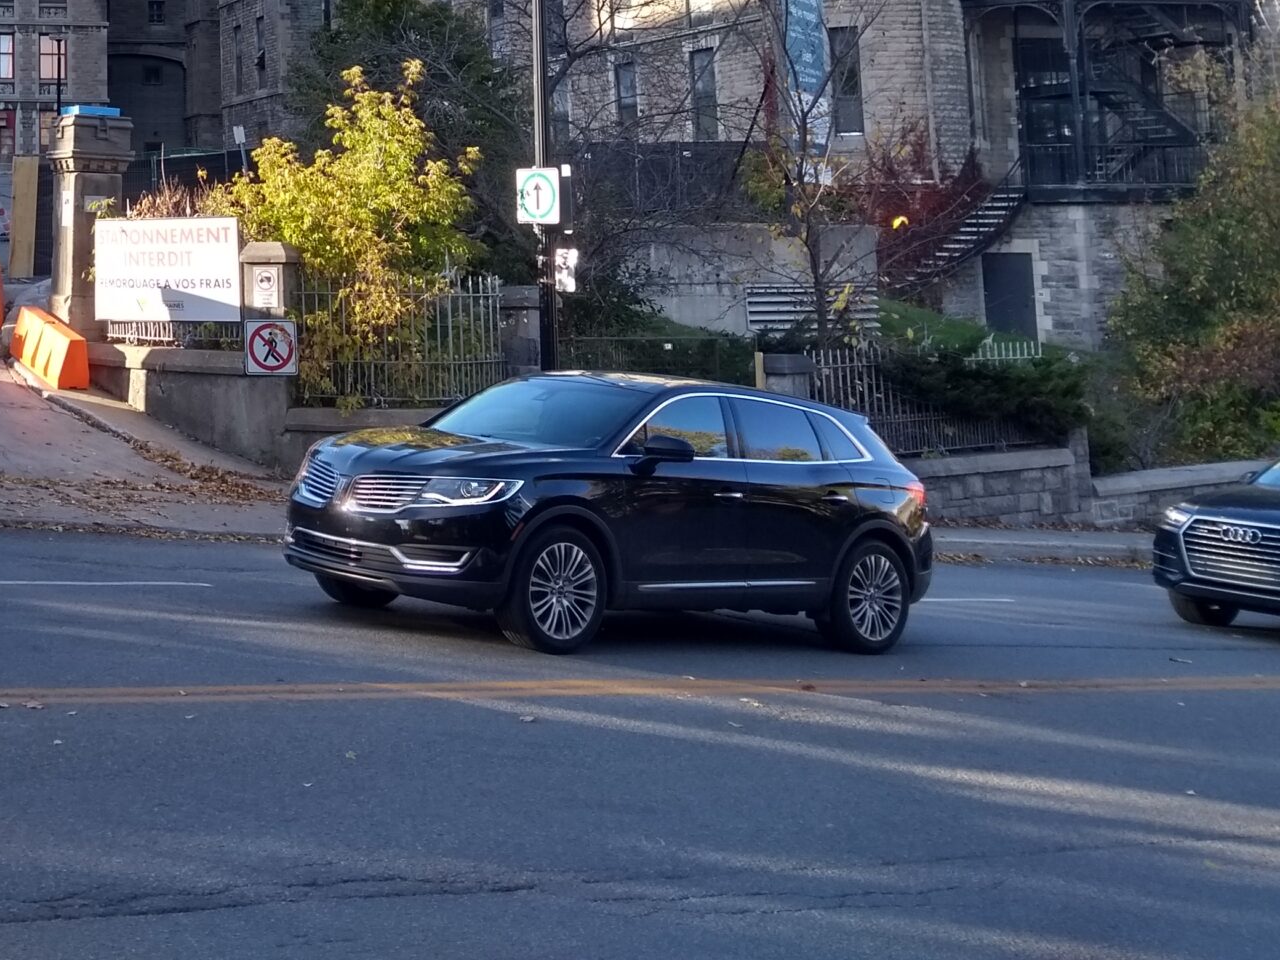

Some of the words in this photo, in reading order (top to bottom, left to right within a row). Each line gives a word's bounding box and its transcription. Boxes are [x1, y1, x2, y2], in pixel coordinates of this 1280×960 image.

[124, 251, 192, 267] INTERDIT
[174, 278, 196, 289] VOS
[200, 278, 232, 289] FRAIS
